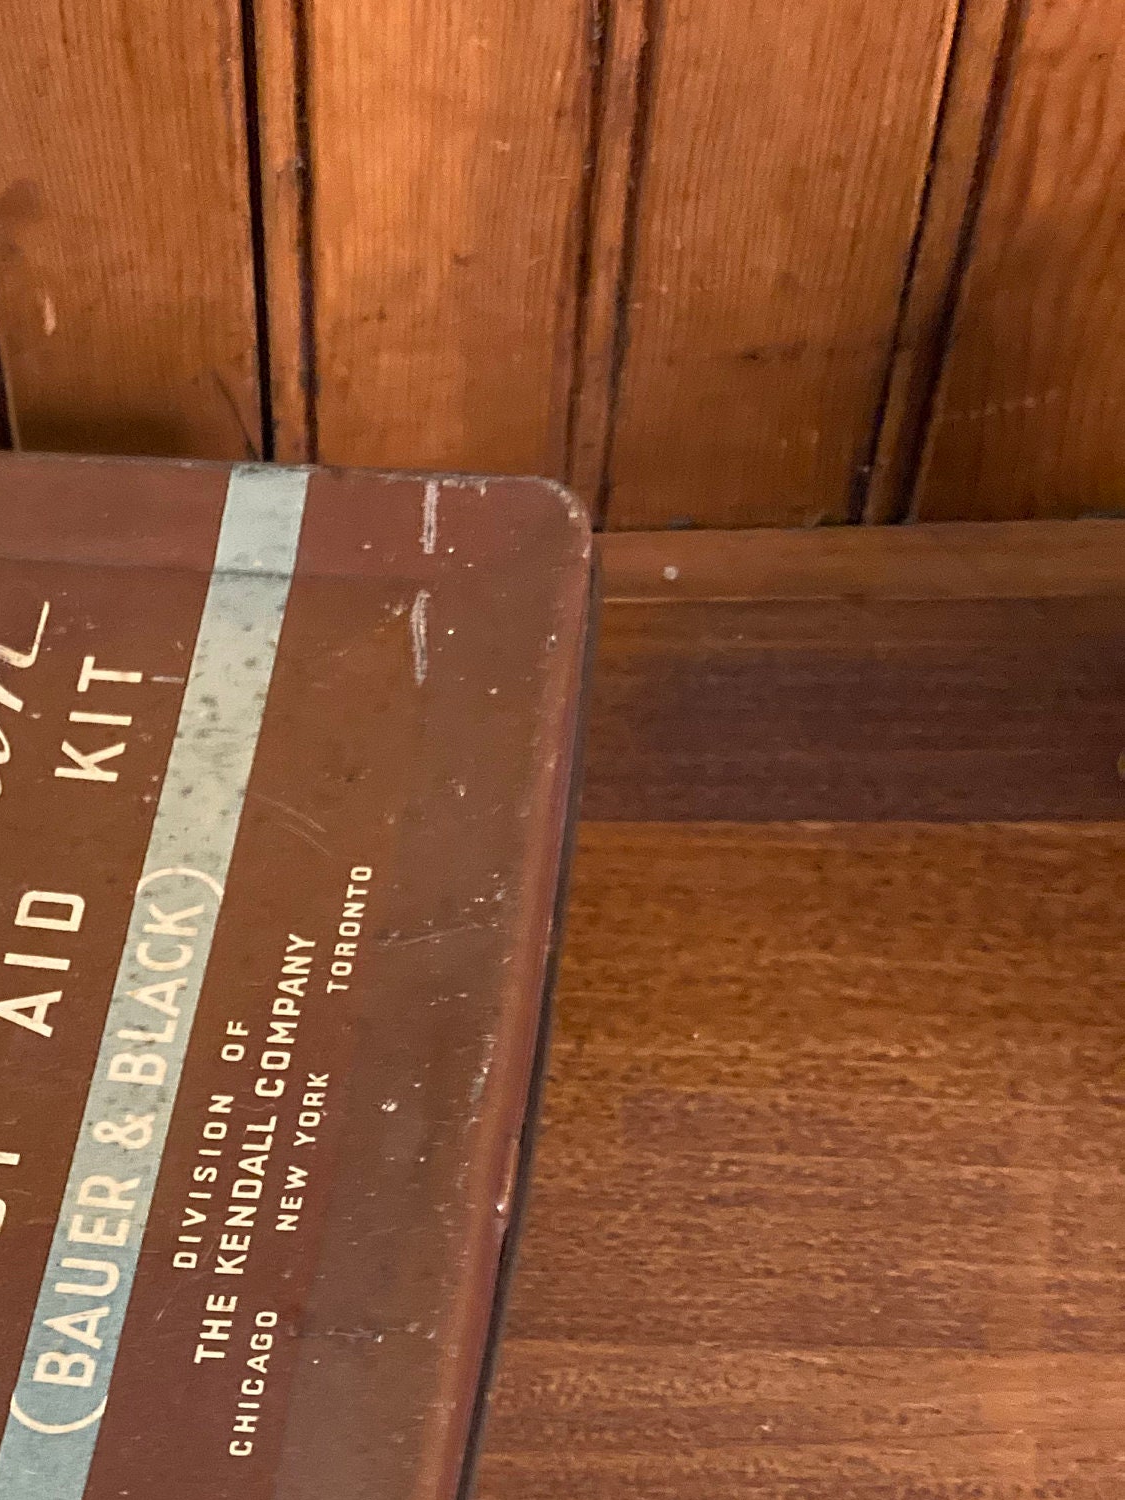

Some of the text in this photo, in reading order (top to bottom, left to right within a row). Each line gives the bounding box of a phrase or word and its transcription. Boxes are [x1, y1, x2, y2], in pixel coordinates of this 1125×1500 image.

[53, 655, 143, 783] KIT
[93, 1111, 156, 1150] &
[173, 1020, 250, 1271] DIVISION OF
[194, 932, 317, 1366] THE KENDALL COMPANY
[229, 865, 374, 1457] CHICAGO NEW YORK TORONTO
